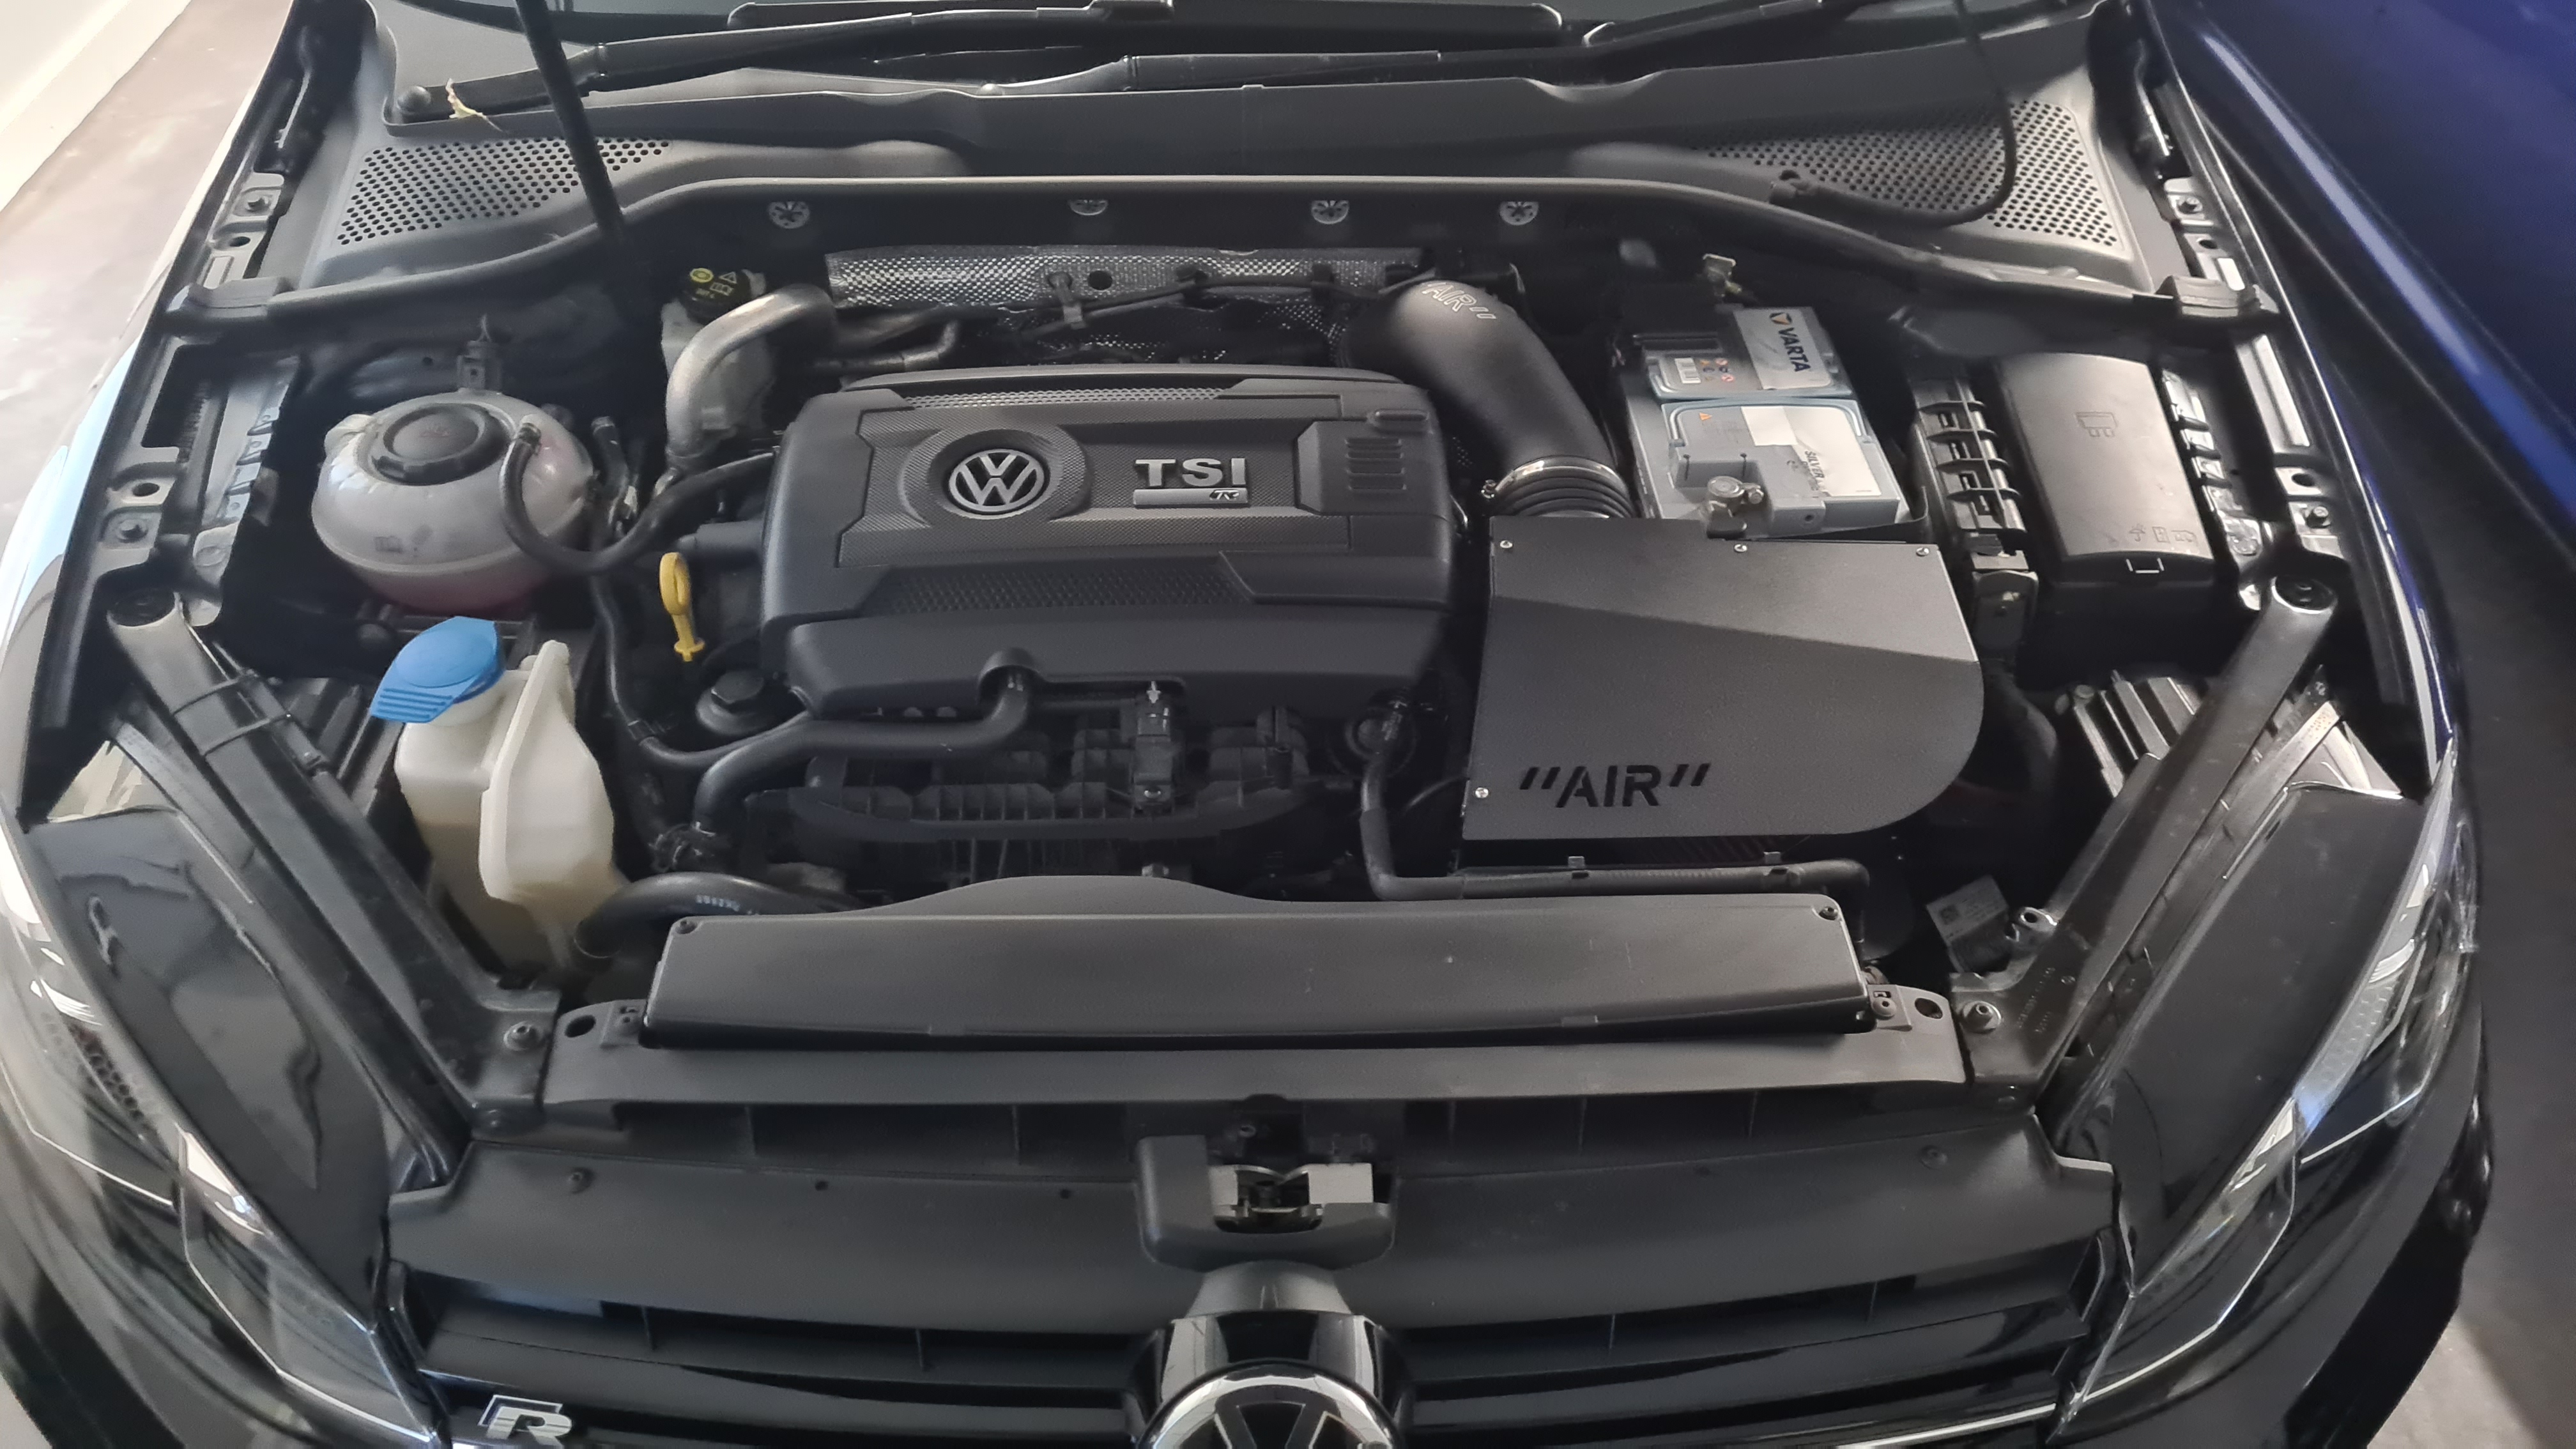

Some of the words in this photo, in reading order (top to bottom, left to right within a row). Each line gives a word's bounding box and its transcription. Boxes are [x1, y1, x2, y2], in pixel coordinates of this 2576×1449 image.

[1778, 327, 1811, 372] VARTA
[1135, 457, 1246, 487] TSI
[1804, 450, 1825, 479] SILVER
[479, 1397, 572, 1449] R
